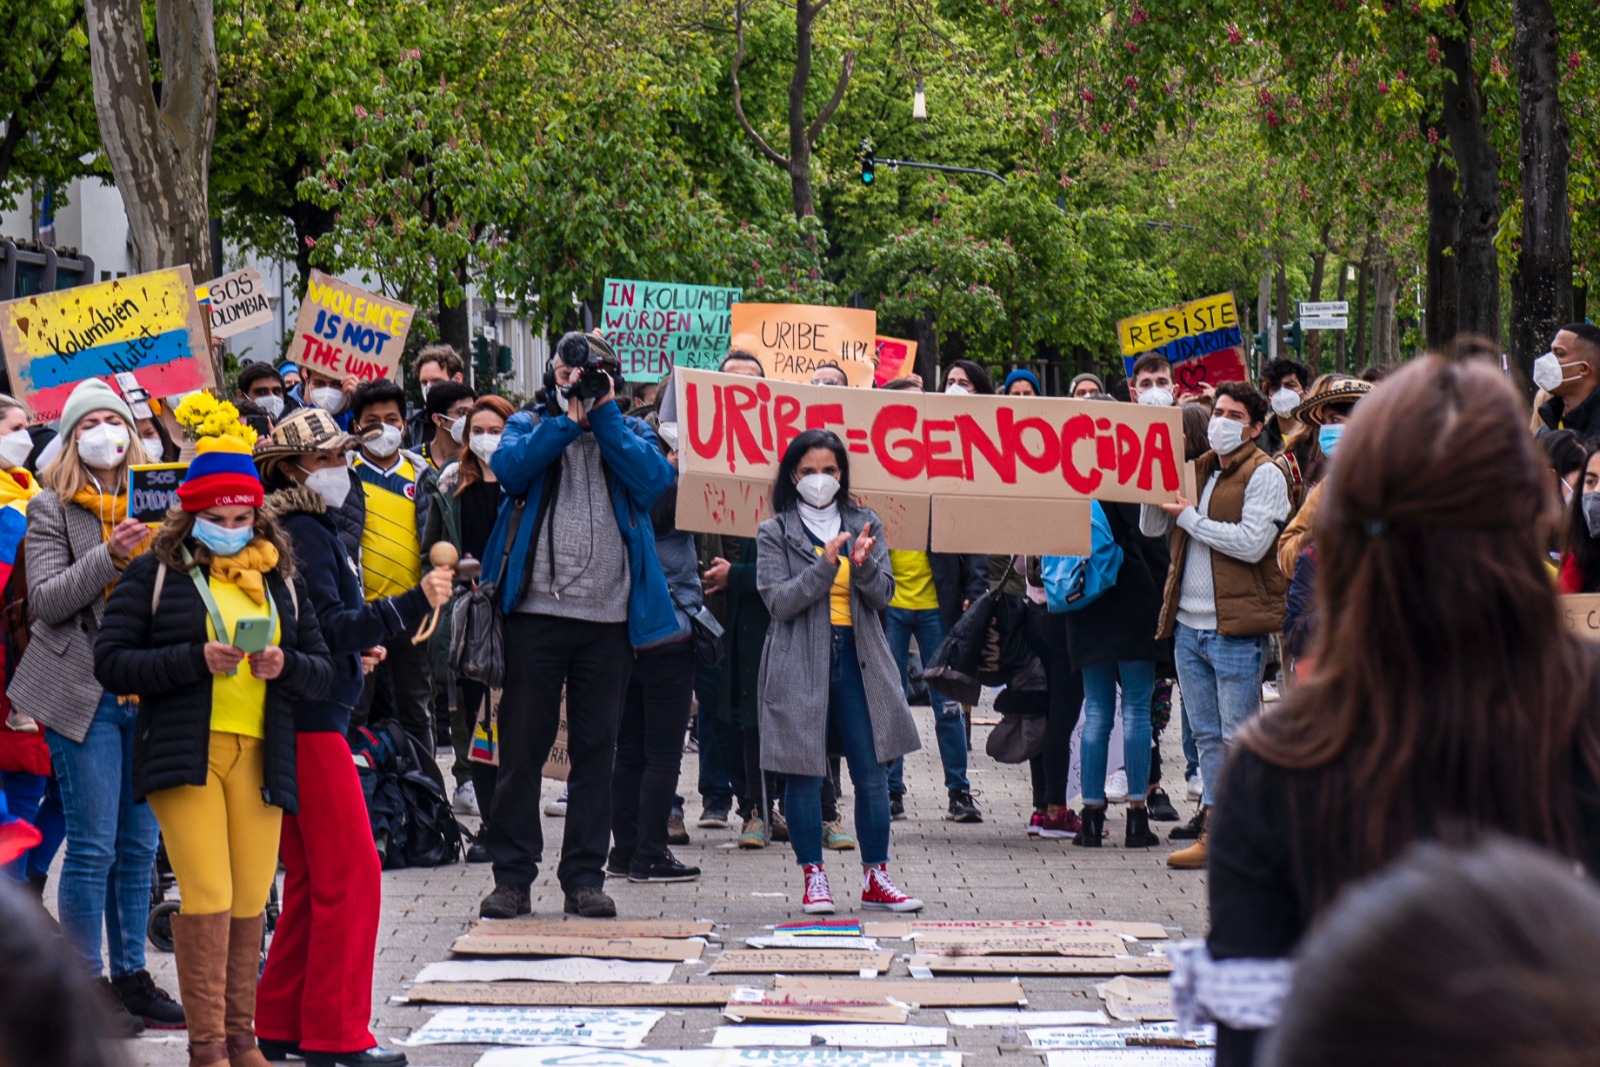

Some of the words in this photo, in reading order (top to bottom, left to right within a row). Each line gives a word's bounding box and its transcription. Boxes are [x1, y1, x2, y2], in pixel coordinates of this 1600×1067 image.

[210, 273, 253, 304] SOS
[606, 282, 635, 307] IN
[643, 286, 741, 312] KOLUMBIE
[211, 293, 268, 329] OLOMBIA
[308, 280, 409, 337] VIOLENCE
[605, 309, 691, 333] WÜRDEN
[47, 299, 139, 365] Kolumbien
[314, 310, 341, 339] IS
[342, 322, 391, 355] NOT
[604, 331, 671, 349] GERADE
[761, 321, 829, 352] URIBE
[104, 325, 160, 374] blutet
[302, 334, 342, 372] THE
[345, 354, 389, 384] WAY
[618, 349, 675, 374] EBEN
